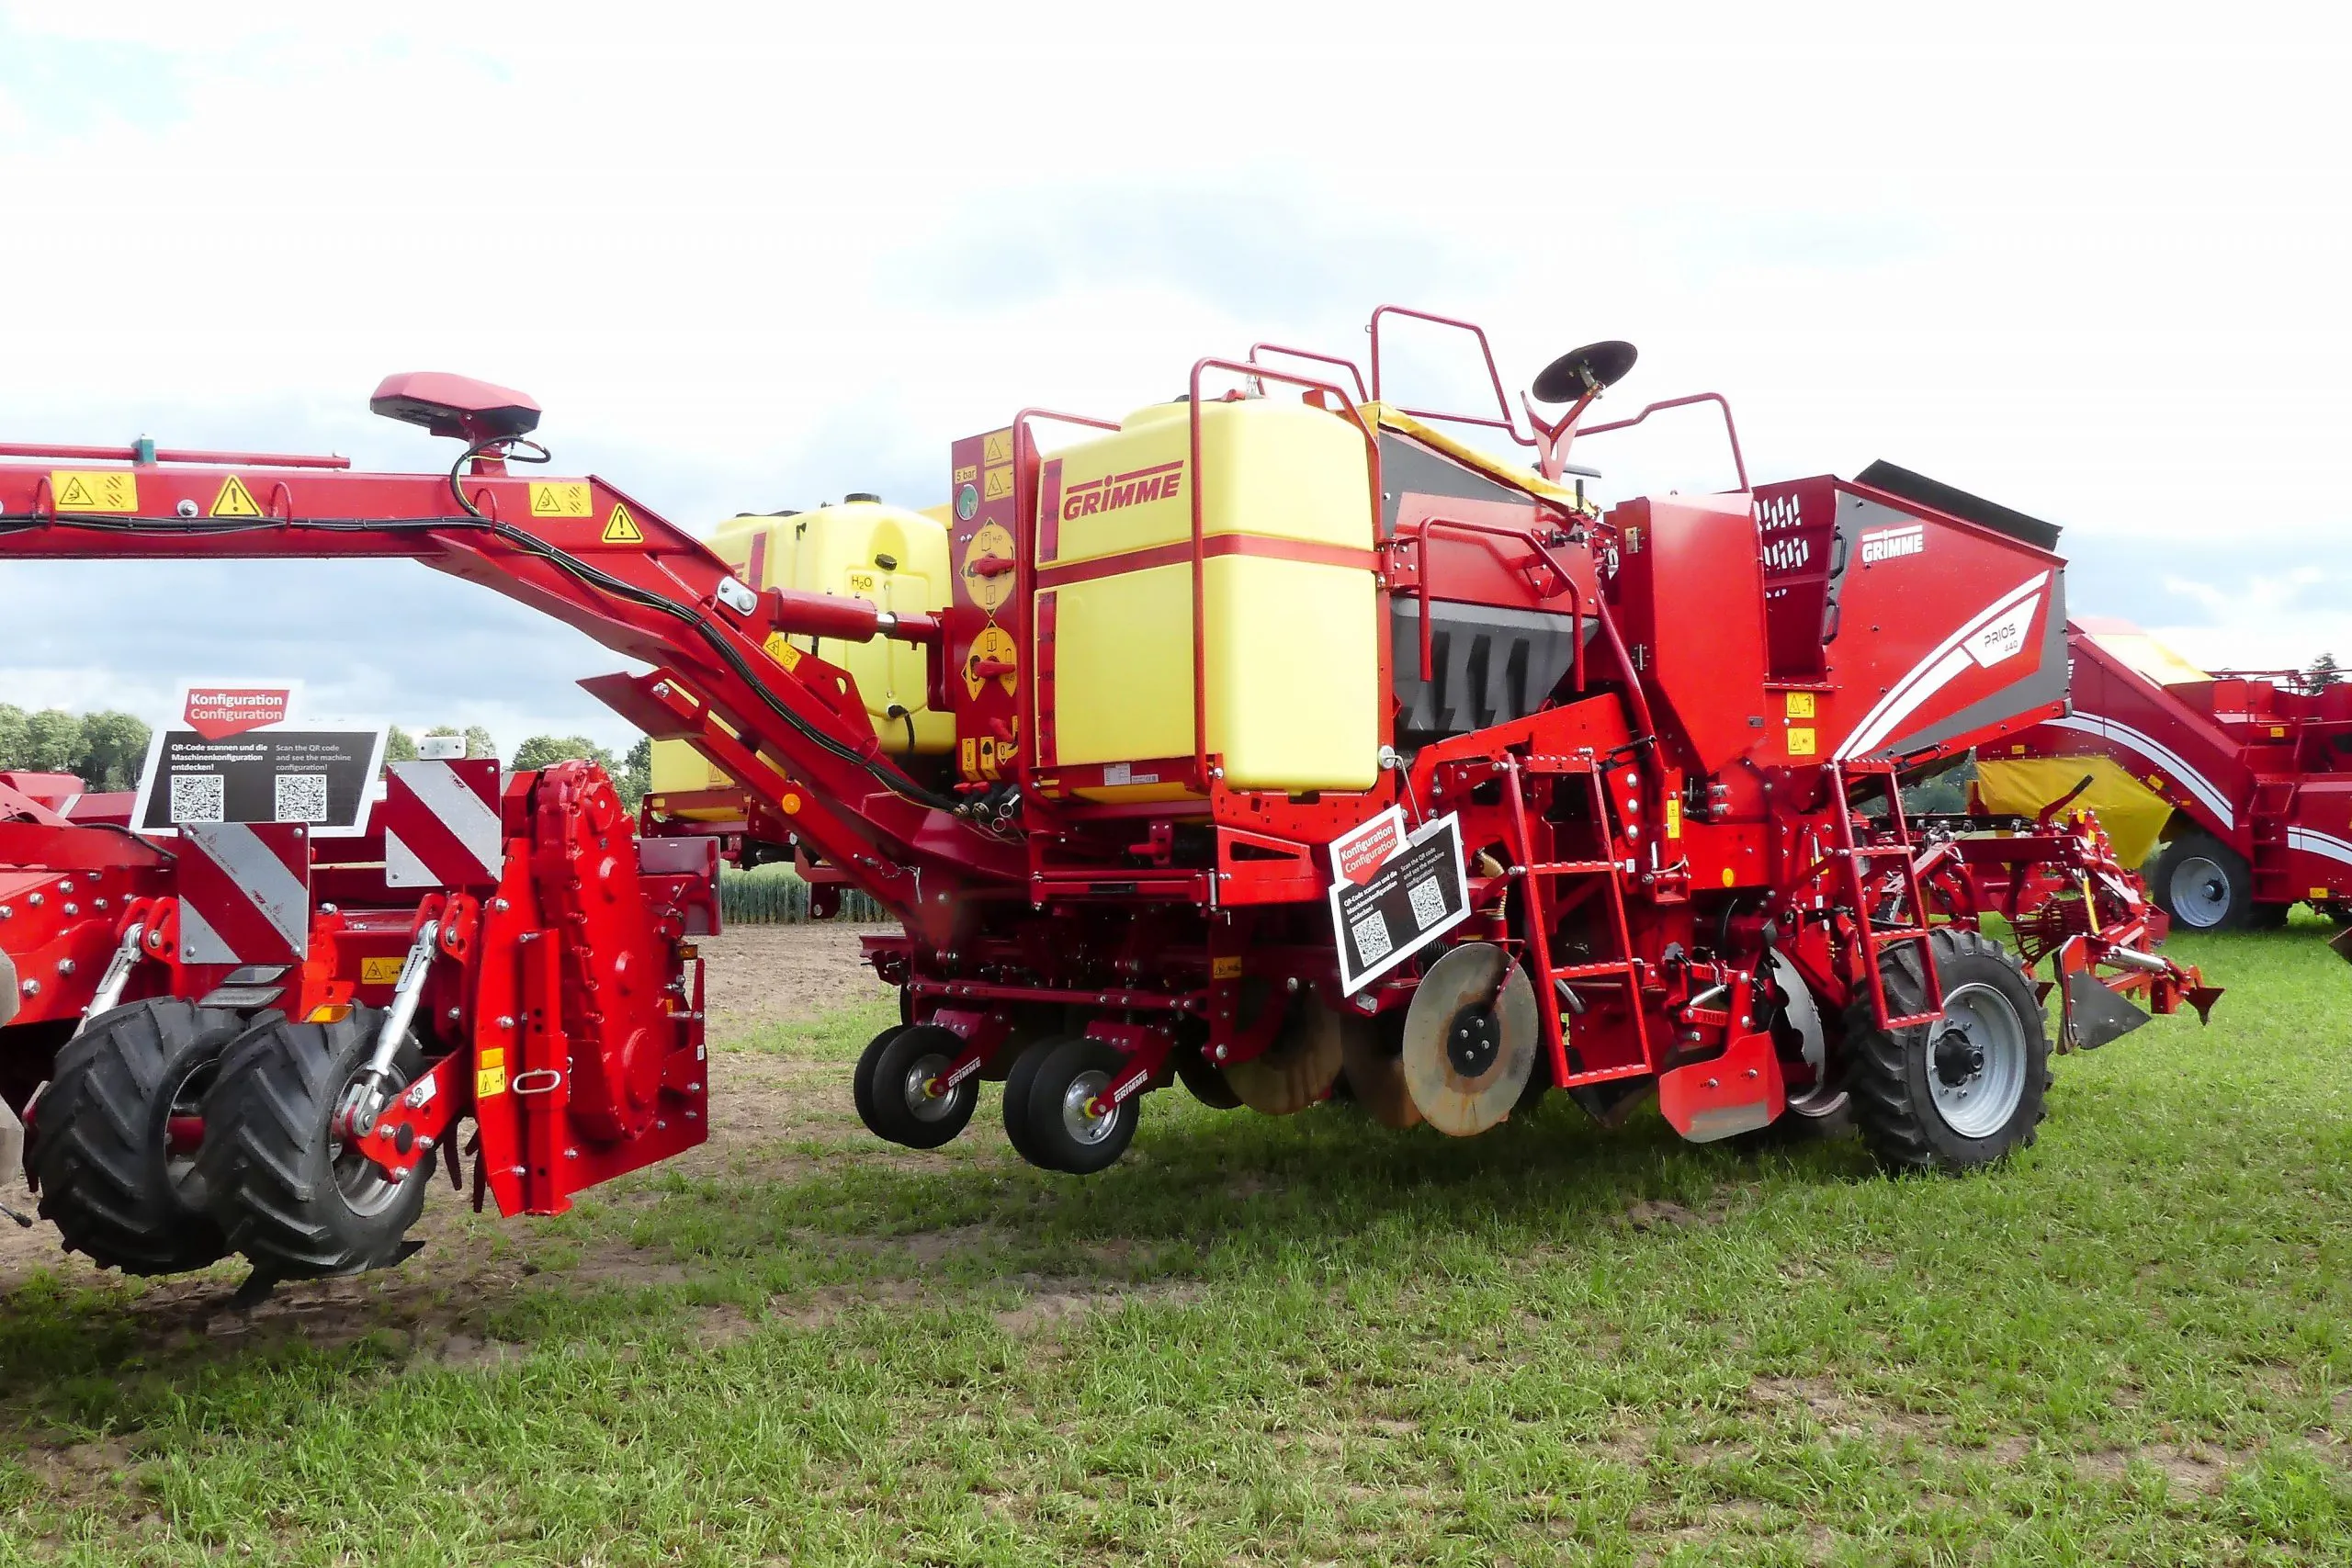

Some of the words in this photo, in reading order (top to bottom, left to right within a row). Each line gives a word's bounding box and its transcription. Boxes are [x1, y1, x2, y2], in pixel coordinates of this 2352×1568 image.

[956, 471, 962, 481] 5
[963, 468, 977, 479] bar
[1063, 471, 1182, 521] GRIMME
[1862, 529, 1924, 562] GRIMME
[1984, 623, 2016, 648] PRIOS
[2004, 639, 2018, 651] 440
[190, 694, 283, 707] Konfiguration
[190, 708, 284, 722] Configuration
[276, 763, 328, 772] configuration!
[1341, 825, 1394, 861] Konfiguration
[1345, 837, 1397, 873] Configuration
[948, 1059, 981, 1088] GRIMME
[1114, 1071, 1148, 1103] GRIMME
